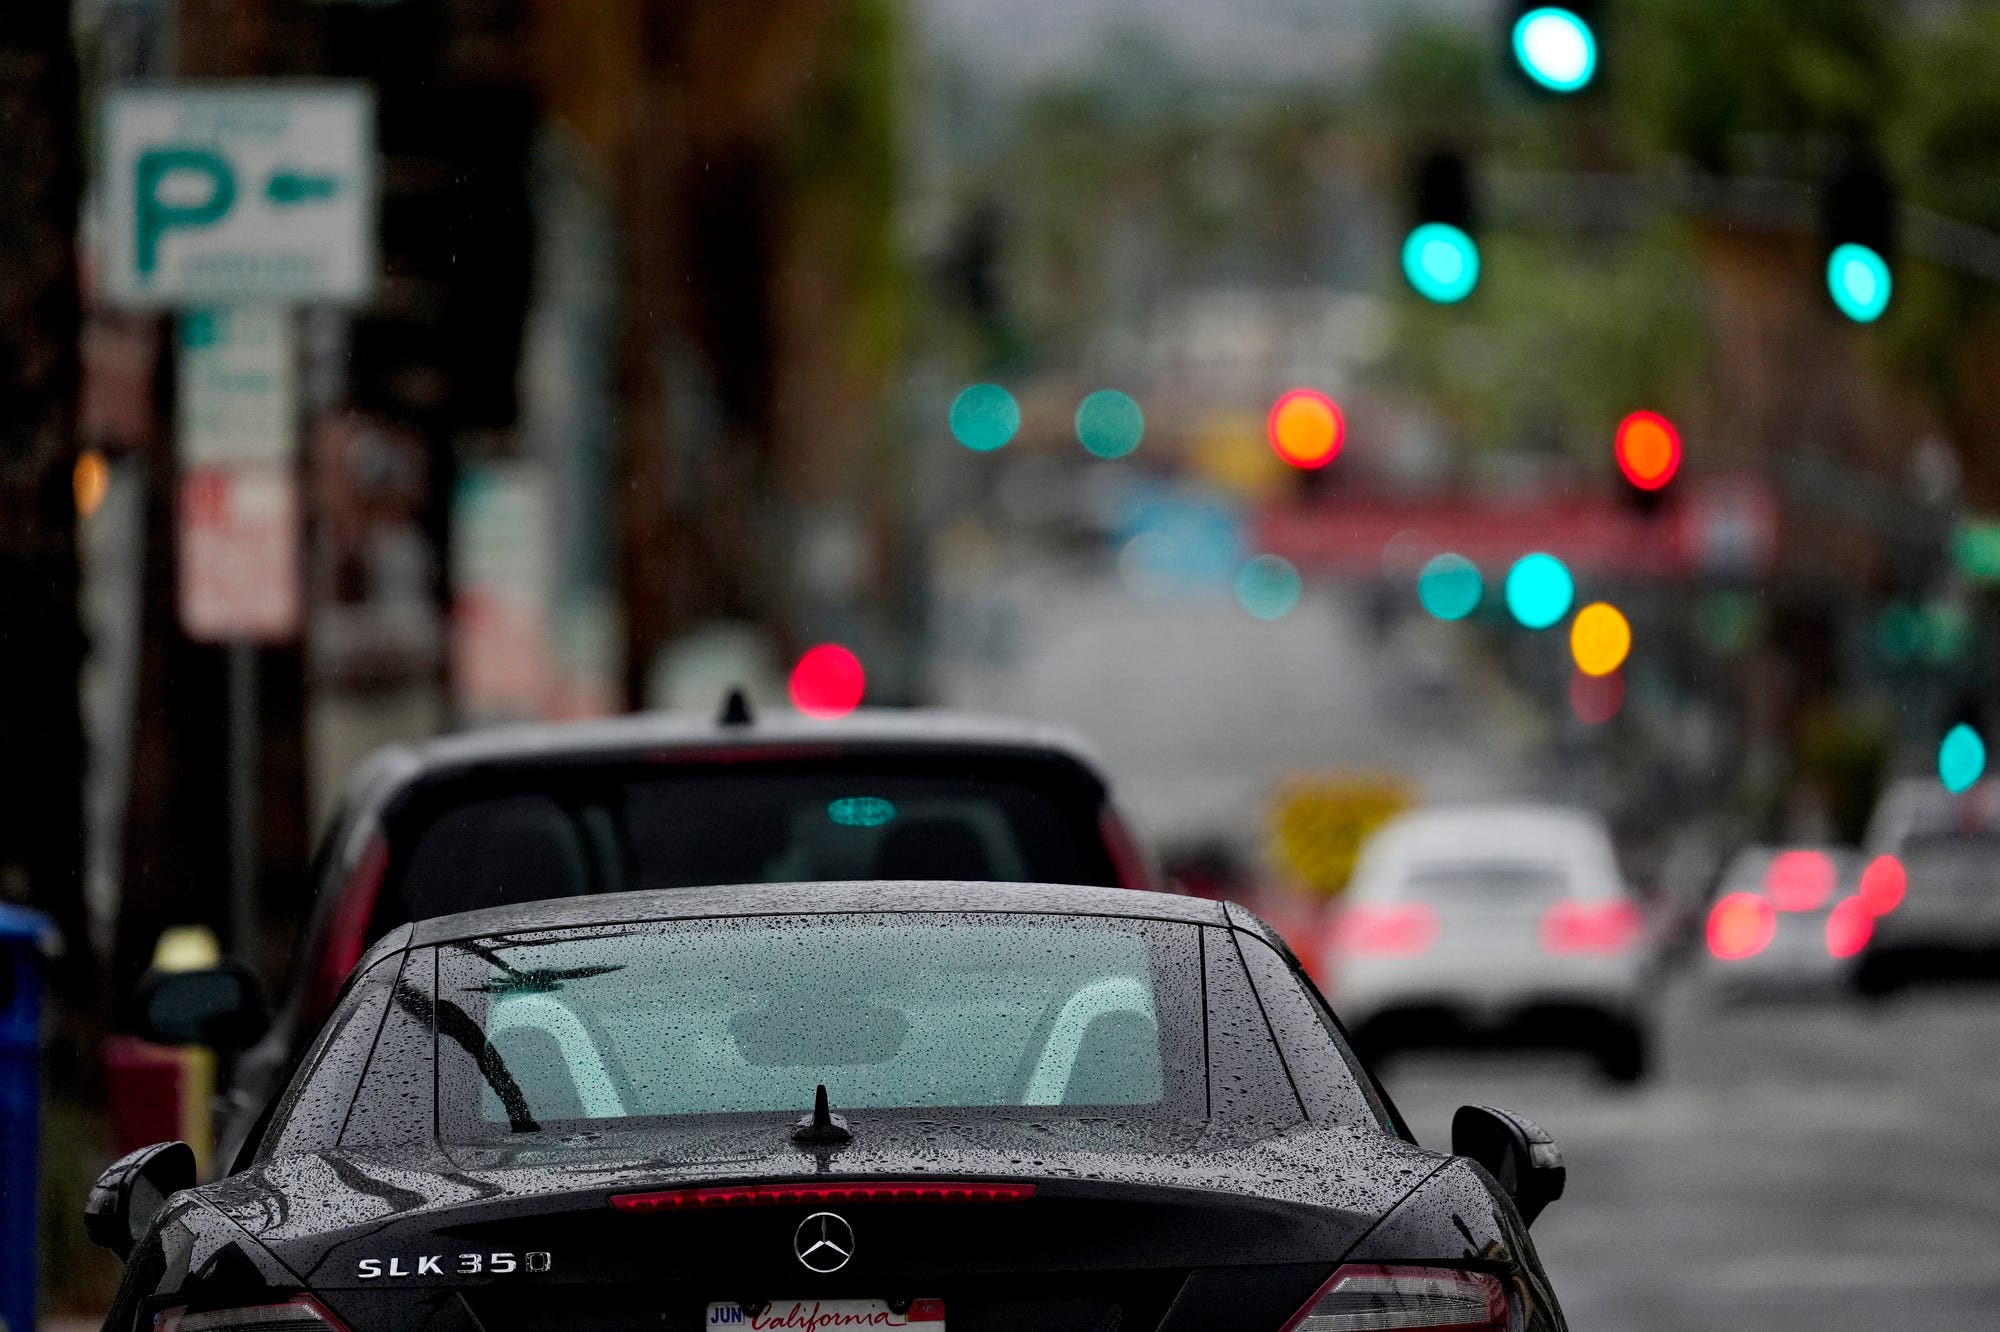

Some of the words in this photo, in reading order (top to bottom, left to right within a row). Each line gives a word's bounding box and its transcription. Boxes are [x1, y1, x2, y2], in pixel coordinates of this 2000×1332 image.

[135, 148, 236, 278] P
[358, 1255, 444, 1278] SLK
[457, 1252, 551, 1274] 350
[710, 1307, 743, 1324] JUN
[751, 1302, 907, 1332] California
